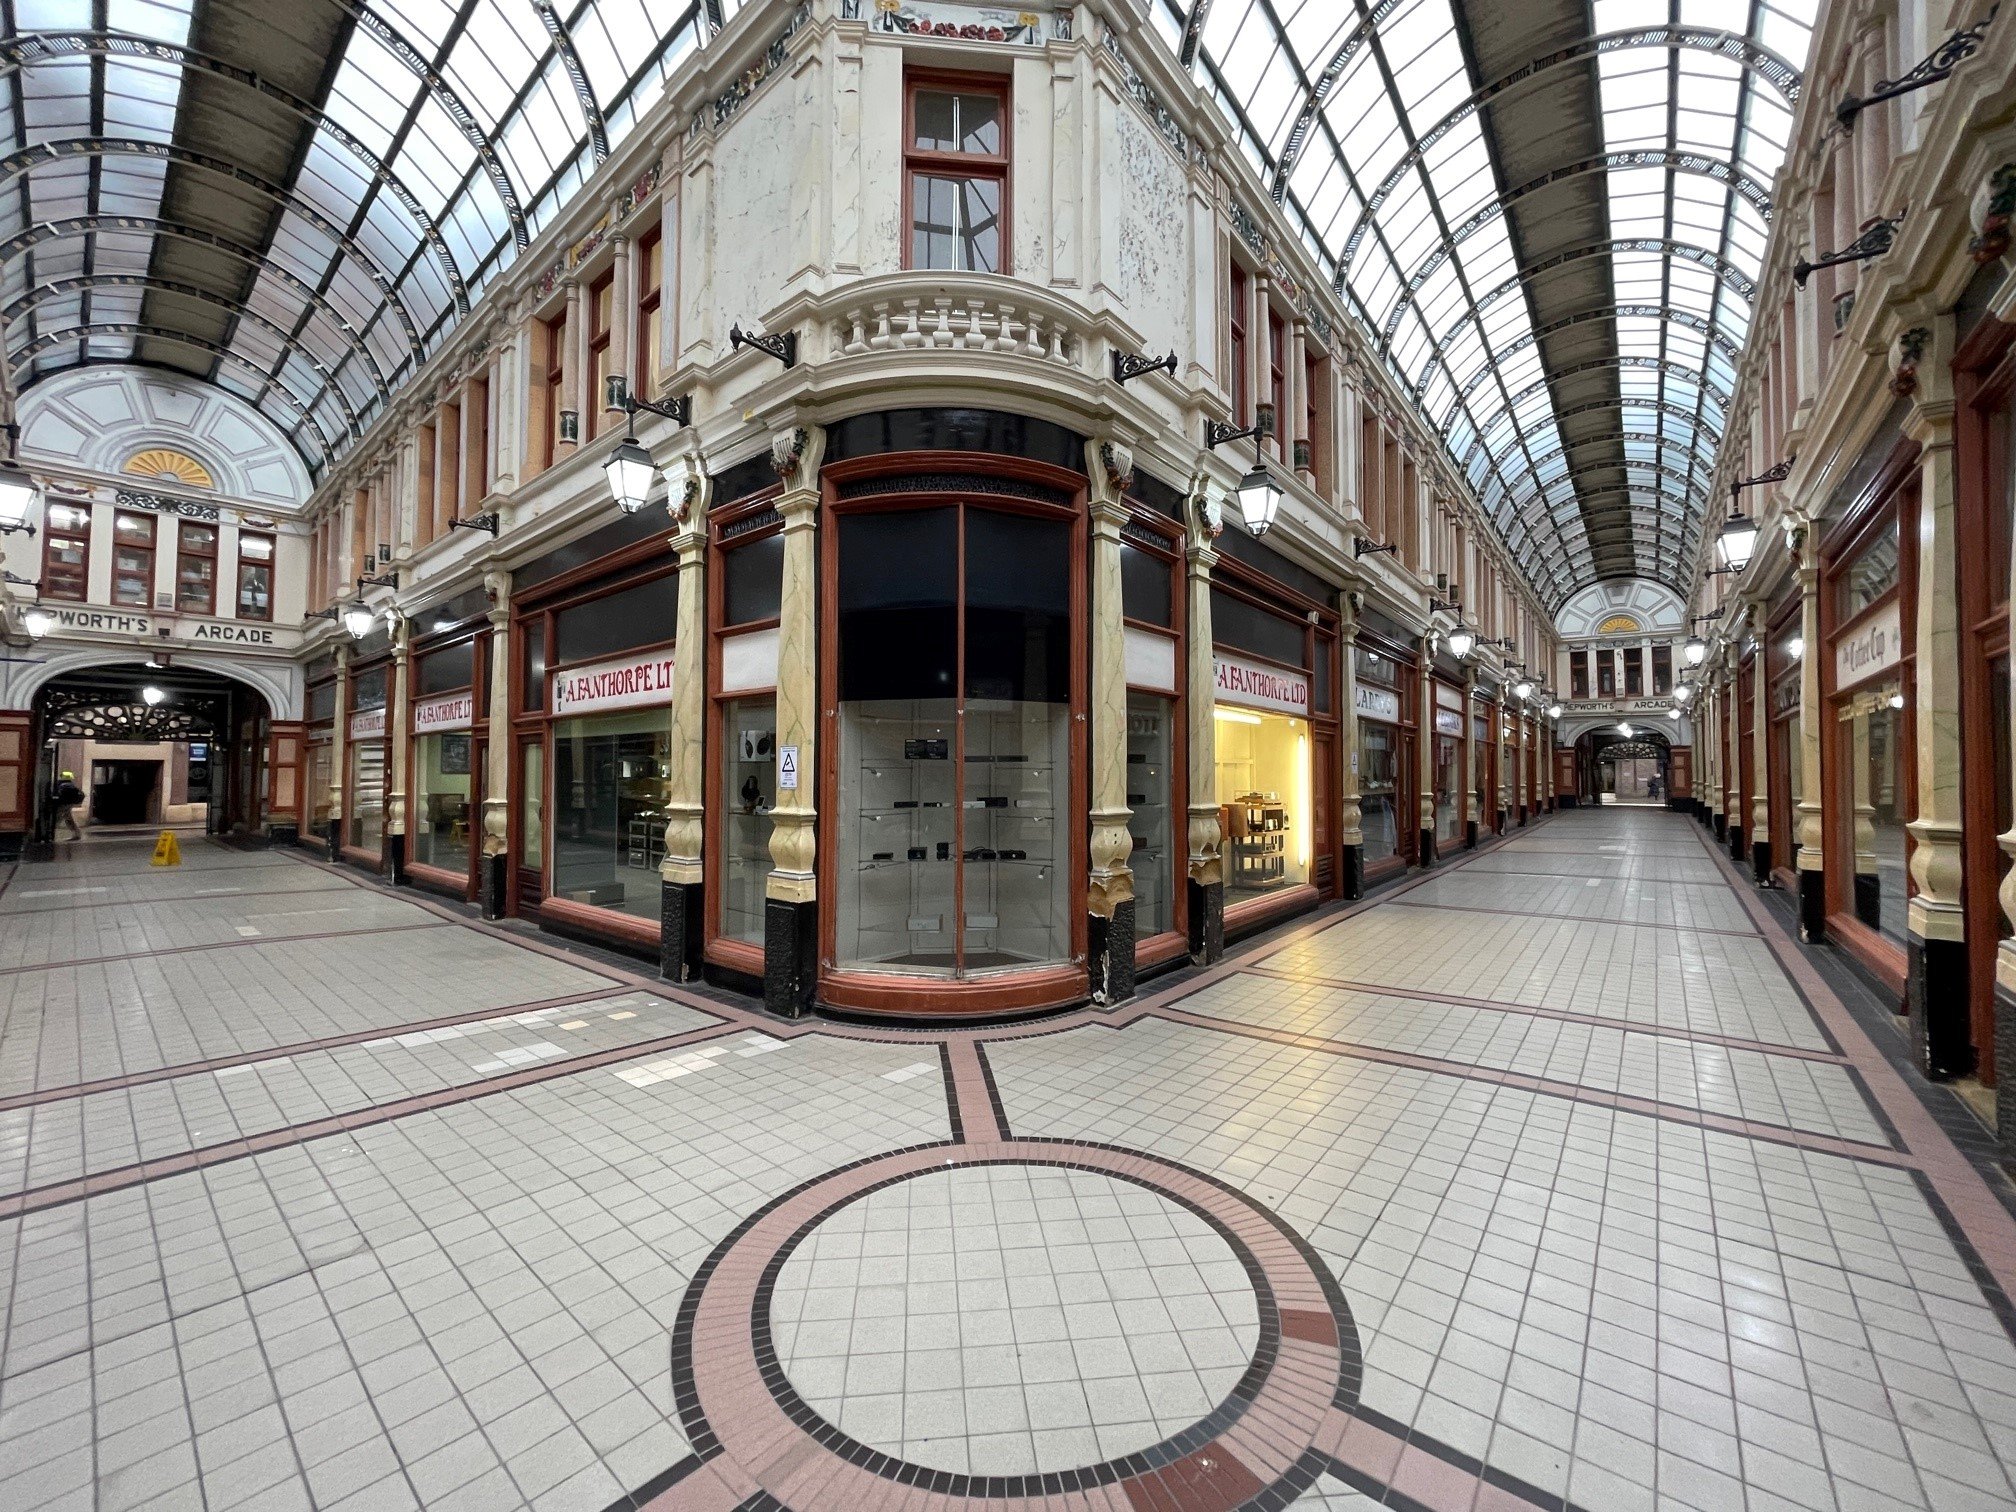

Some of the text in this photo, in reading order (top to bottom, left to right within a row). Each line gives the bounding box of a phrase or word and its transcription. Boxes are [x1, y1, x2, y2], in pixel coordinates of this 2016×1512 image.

[16, 606, 273, 643] HPWORTH'S ARCADE
[656, 660, 675, 690] LT
[1564, 701, 1674, 711] HEPWORTH'S ARCADE
